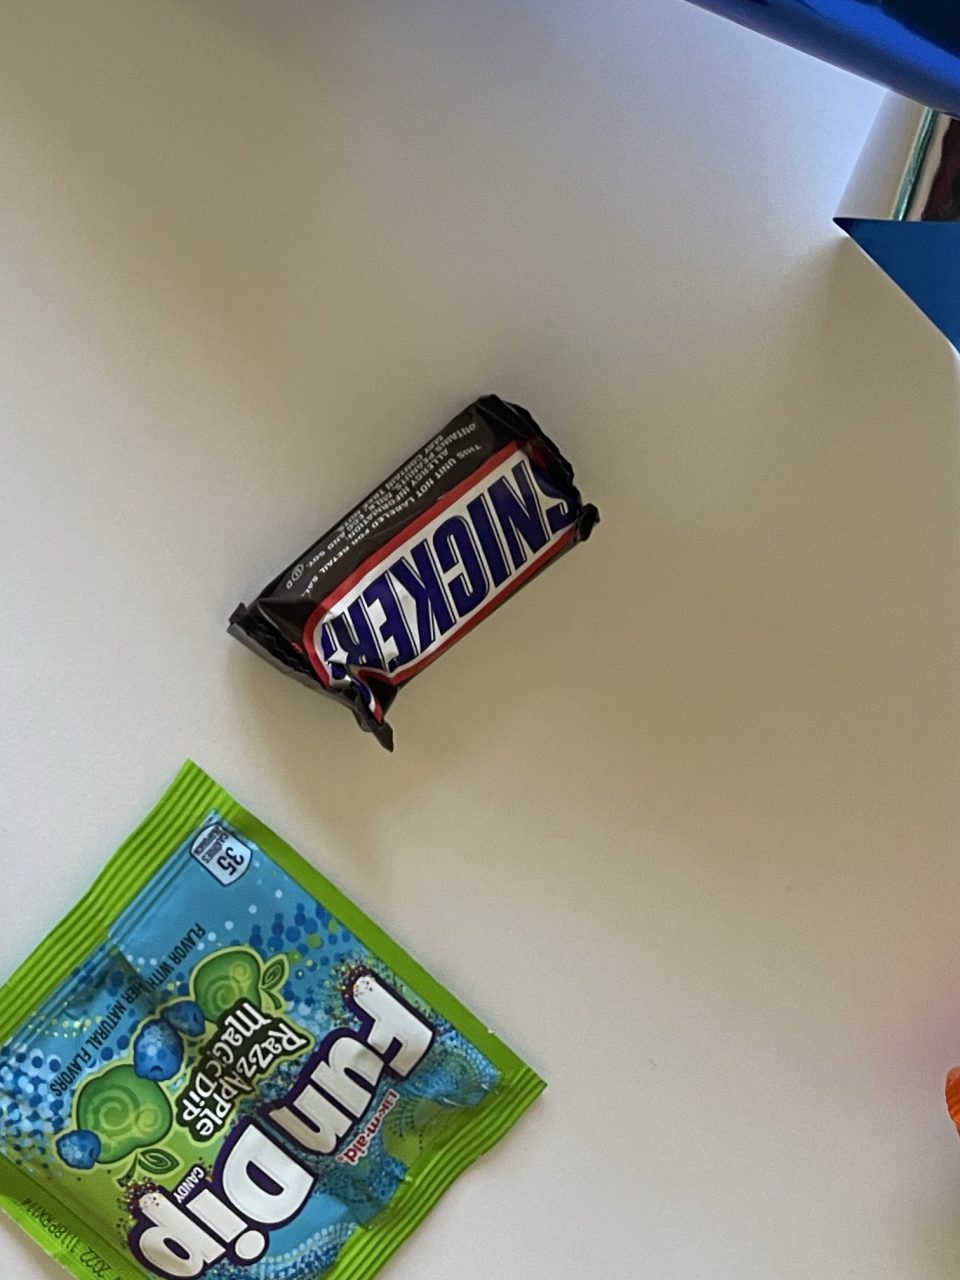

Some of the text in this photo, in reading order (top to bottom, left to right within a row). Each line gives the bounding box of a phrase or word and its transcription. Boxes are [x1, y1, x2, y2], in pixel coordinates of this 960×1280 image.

[434, 457, 456, 479] UNIT
[414, 477, 434, 498] NOT
[214, 845, 246, 876] 35
[47, 922, 207, 1097] FLAVOR WITH HER NATURAL FLAVORS
[138, 976, 434, 1277] Fun Dip
[173, 1167, 205, 1204] CANDY
[78, 1246, 112, 1279] 2022
